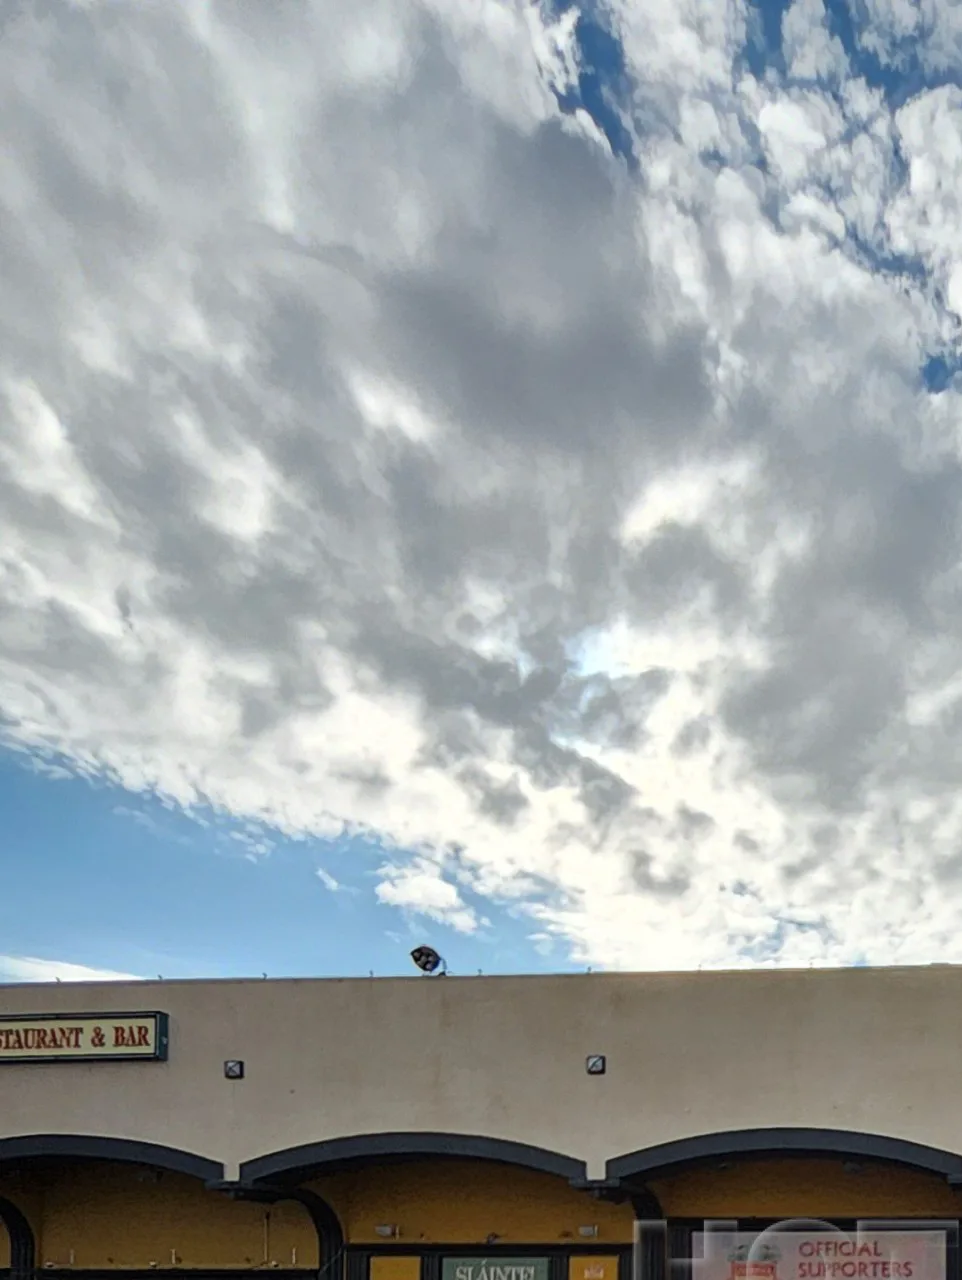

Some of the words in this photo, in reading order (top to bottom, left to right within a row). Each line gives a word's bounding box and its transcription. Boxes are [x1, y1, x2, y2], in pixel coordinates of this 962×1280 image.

[0, 1027, 83, 1050] TAURANT
[91, 1026, 105, 1047] &
[112, 1025, 151, 1047] BAR
[799, 1241, 882, 1257] OFFICIAL
[798, 1261, 913, 1278] SUPPORTERS
